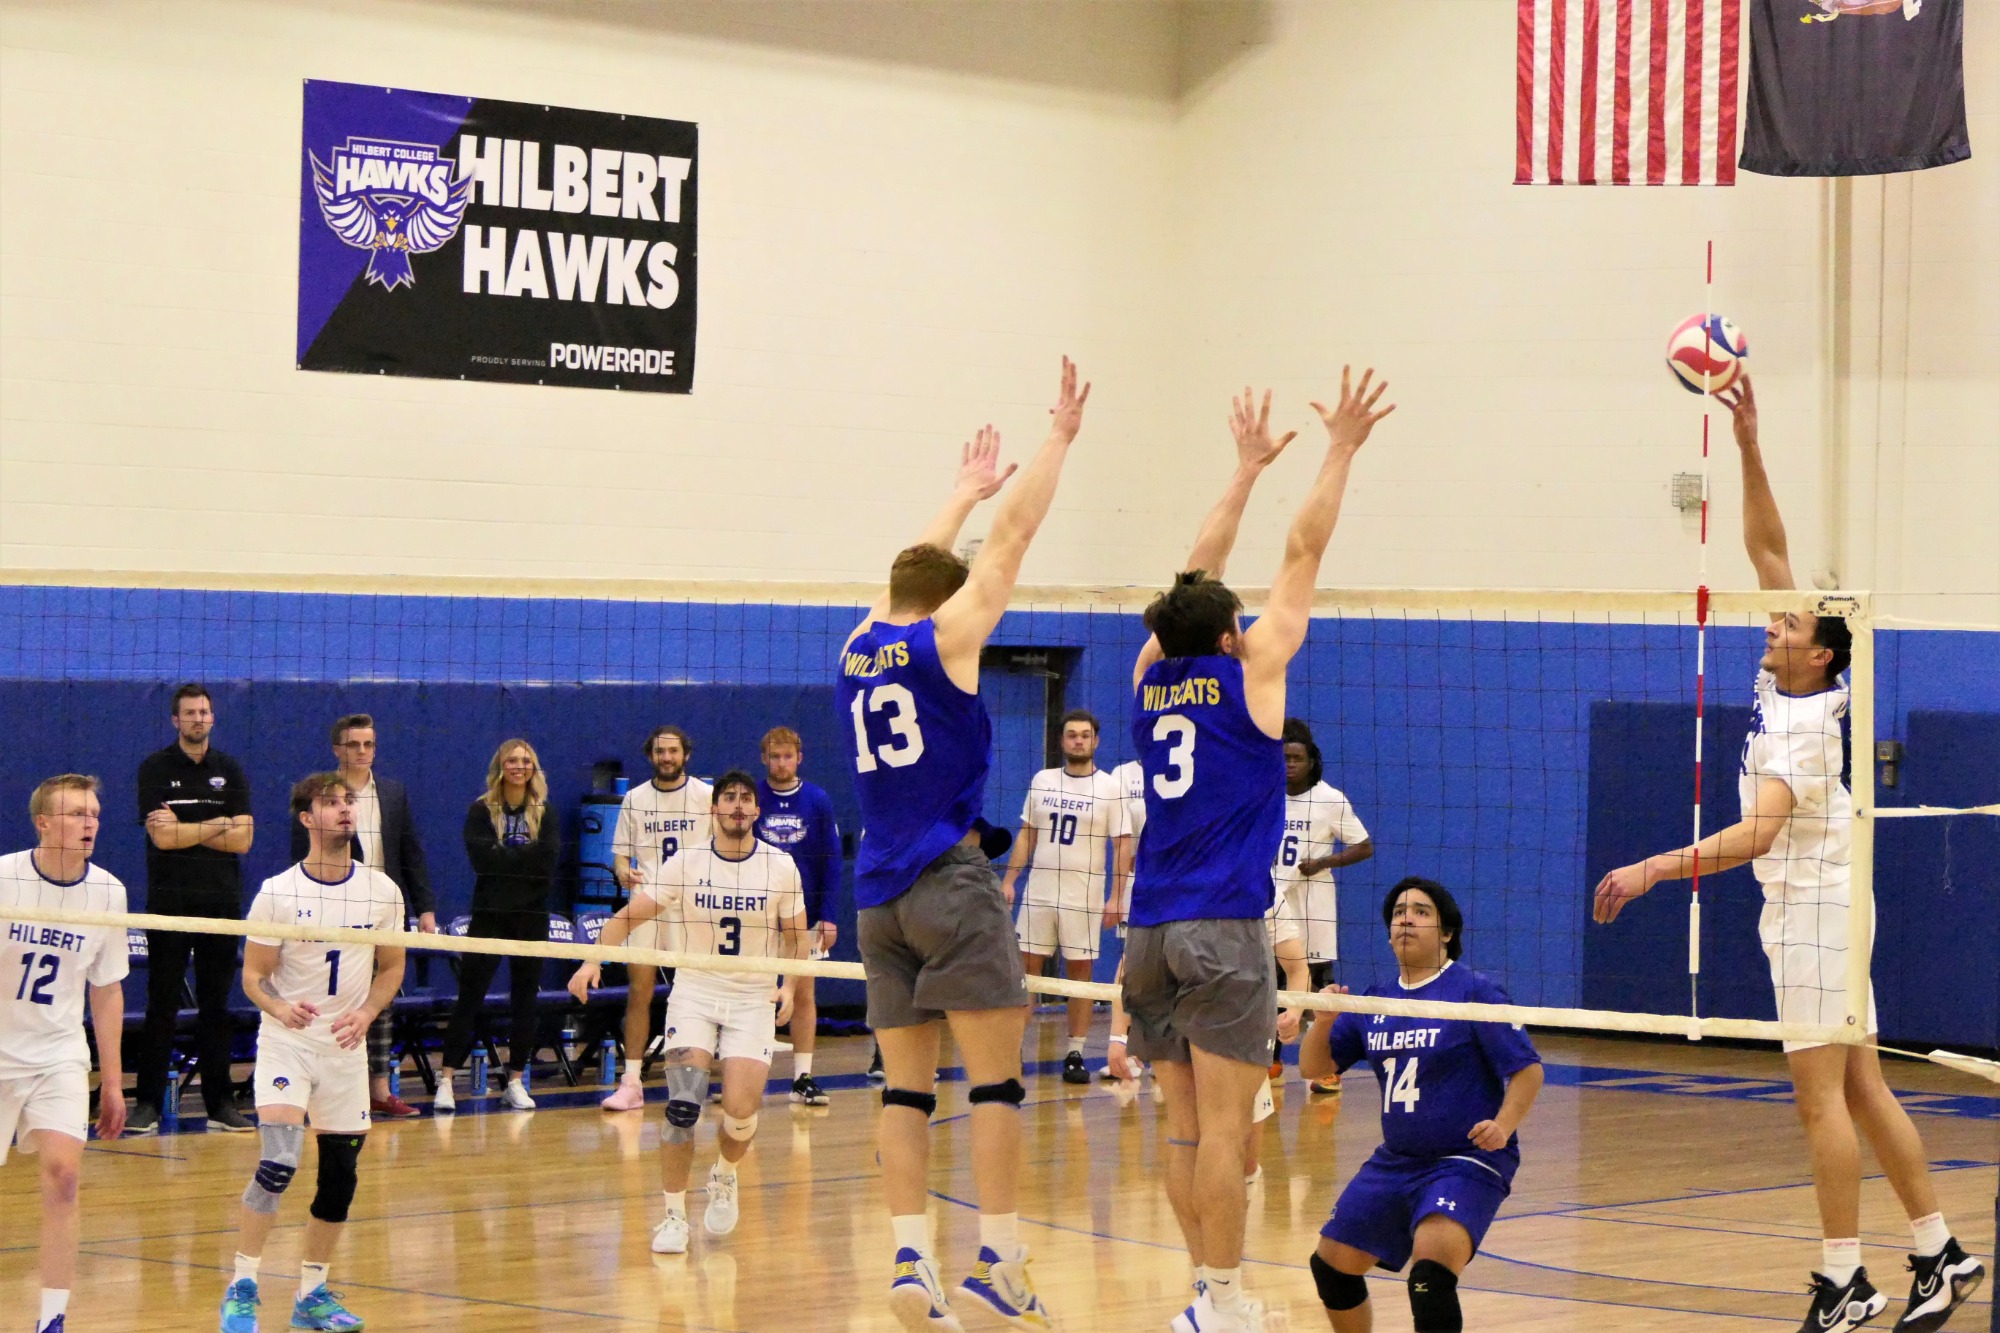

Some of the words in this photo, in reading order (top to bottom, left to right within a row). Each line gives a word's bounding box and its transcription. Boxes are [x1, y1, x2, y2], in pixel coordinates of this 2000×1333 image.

[352, 144, 392, 158] HILBERT
[393, 148, 435, 163] COLLEGE
[336, 156, 449, 207] HAWKS
[459, 134, 692, 223] HILBERT
[463, 224, 680, 310] HAWKS
[471, 355, 509, 366] PROUDLY
[510, 358, 547, 368] SERVING
[550, 342, 676, 376] POWERADE
[844, 640, 911, 678] WILATS
[850, 682, 926, 774] 13
[1152, 714, 1197, 800] 3
[1042, 796, 1093, 813] HILBERT
[644, 819, 697, 834] HILBERT
[1049, 812, 1078, 846] 10
[695, 892, 768, 911] HILBERT
[9, 922, 86, 953] HILBERT
[718, 916, 742, 956] 3
[16, 951, 61, 1006] 12
[325, 950, 342, 996] 1
[1367, 1028, 1441, 1051] HILBERT
[1382, 1057, 1420, 1114] 14
